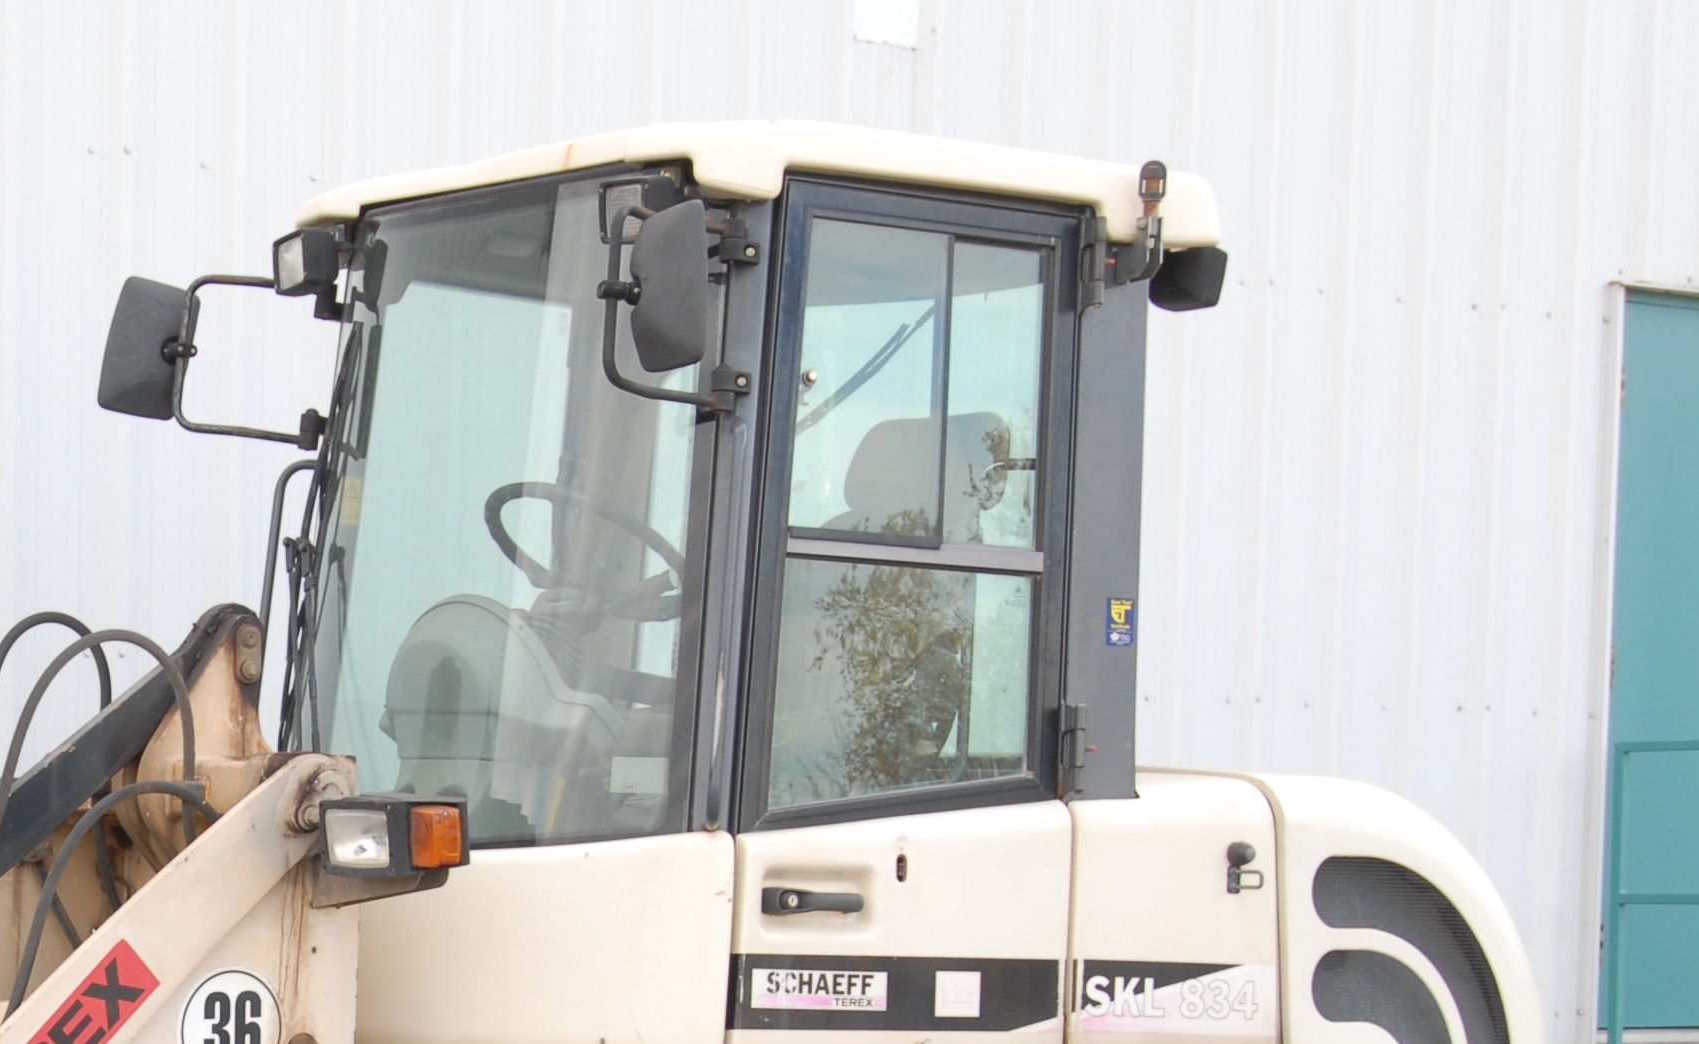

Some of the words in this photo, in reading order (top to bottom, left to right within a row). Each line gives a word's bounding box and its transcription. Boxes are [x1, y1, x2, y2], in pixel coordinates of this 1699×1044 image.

[766, 971, 874, 996] SCHAEFF
[834, 997, 873, 1007] TEREX
[1084, 975, 1165, 1018] SKL
[1179, 978, 1259, 1021] 834
